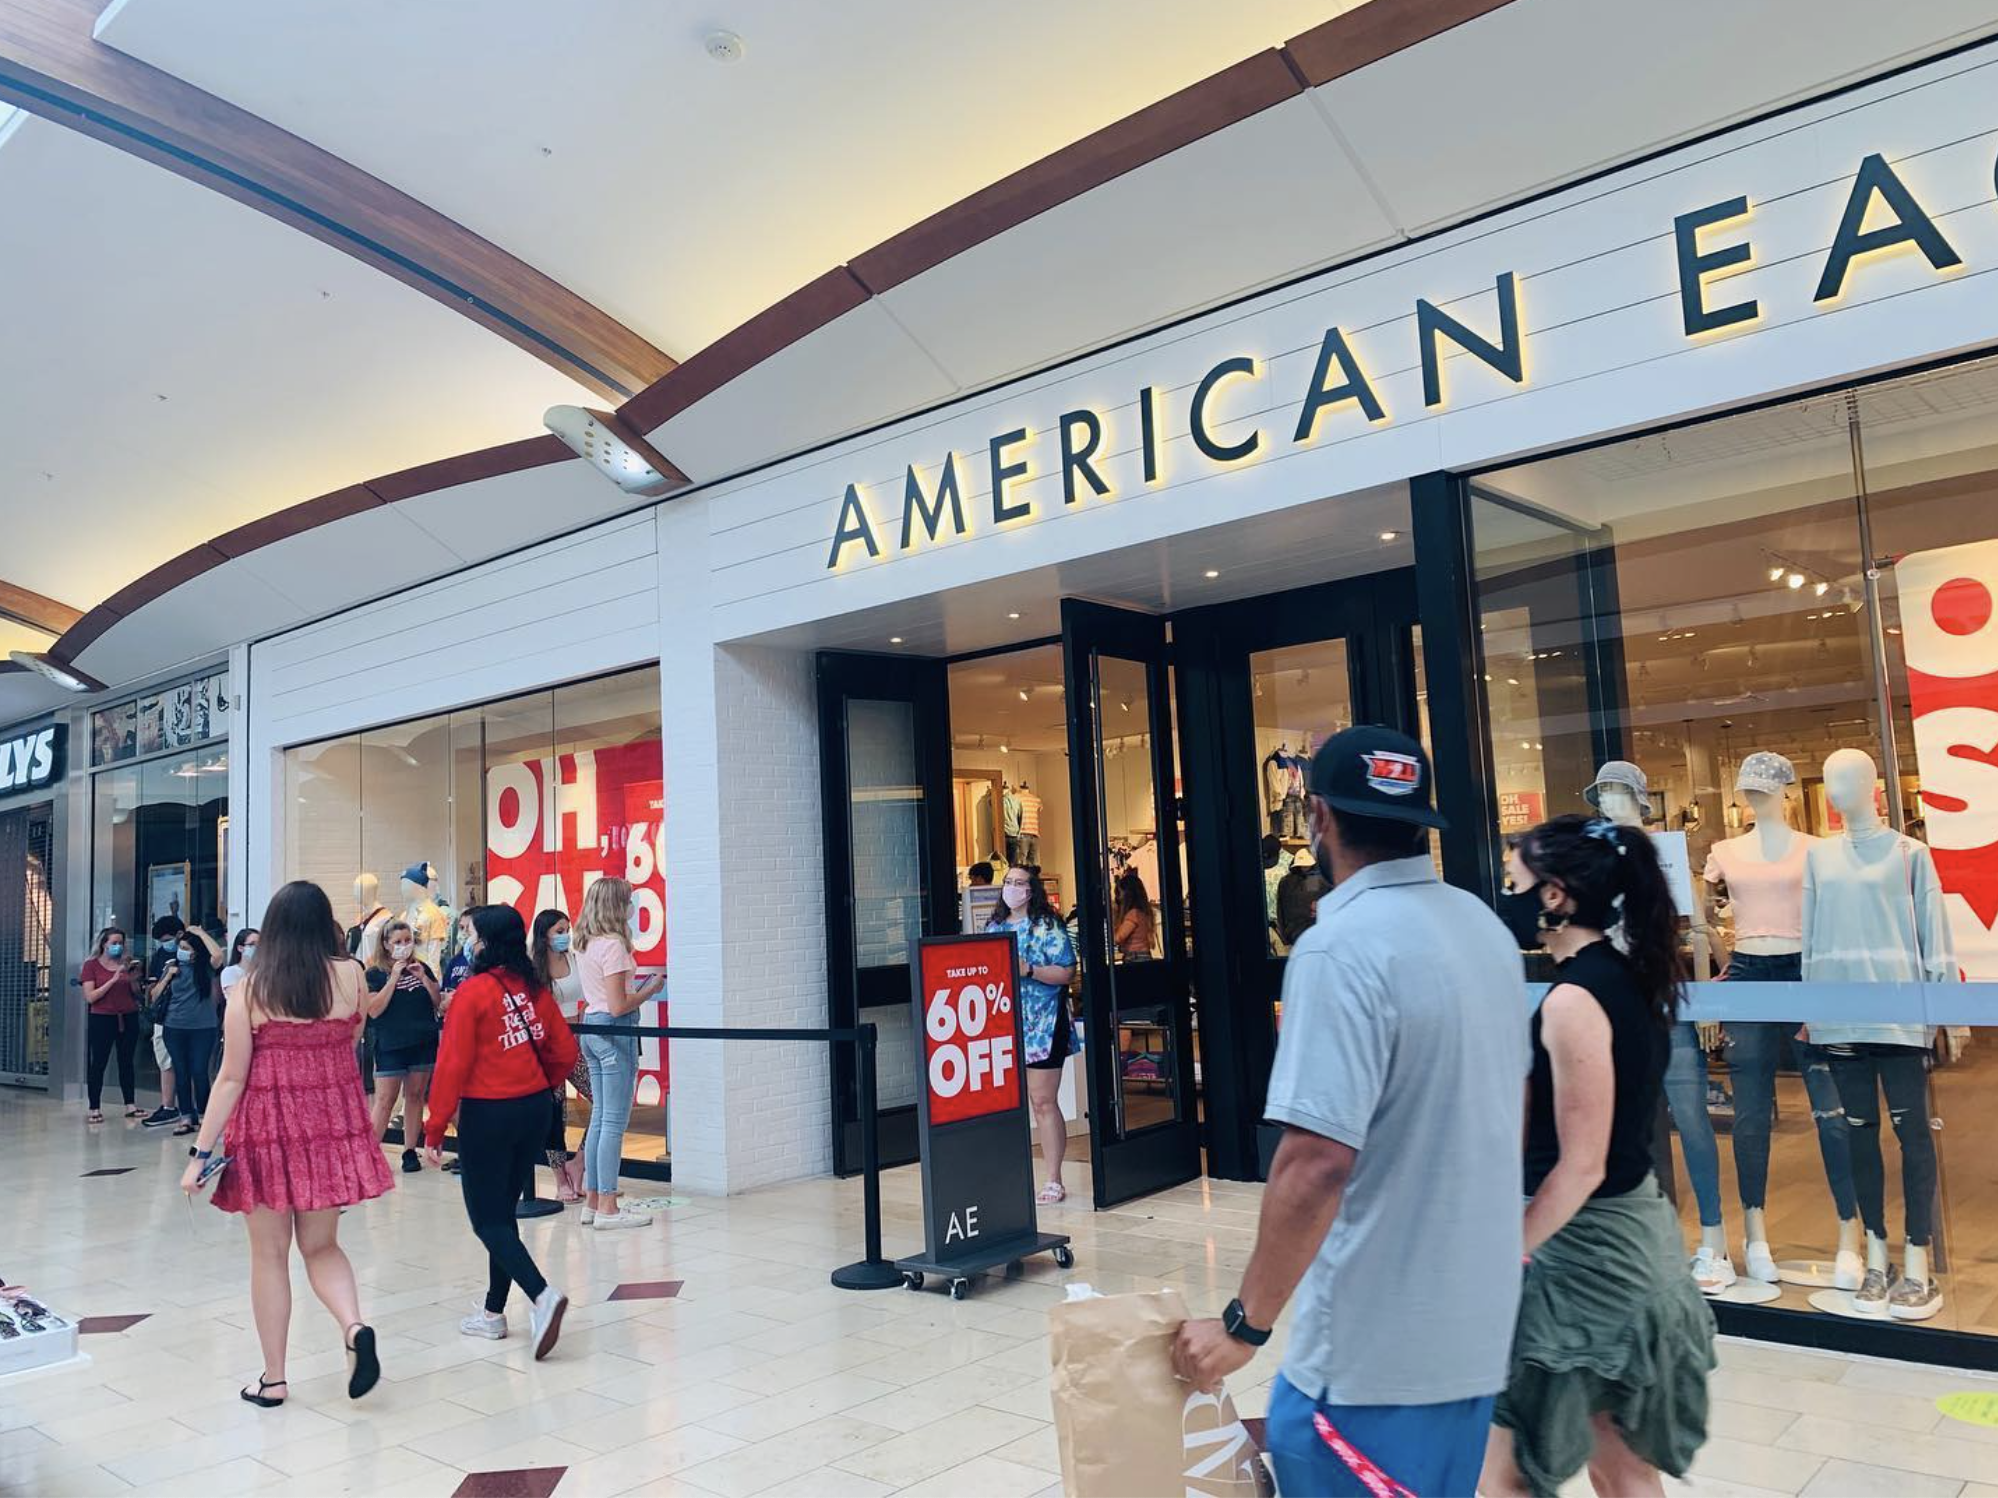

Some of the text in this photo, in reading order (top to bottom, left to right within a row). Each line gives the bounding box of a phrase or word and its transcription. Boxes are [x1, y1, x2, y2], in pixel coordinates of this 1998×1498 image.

[826, 152, 1998, 569] AMERICAN EA
[946, 965, 988, 978] TAKE UP TO
[926, 981, 1011, 1042] 60%
[929, 1035, 1013, 1098] OFF
[945, 1205, 979, 1244] AE
